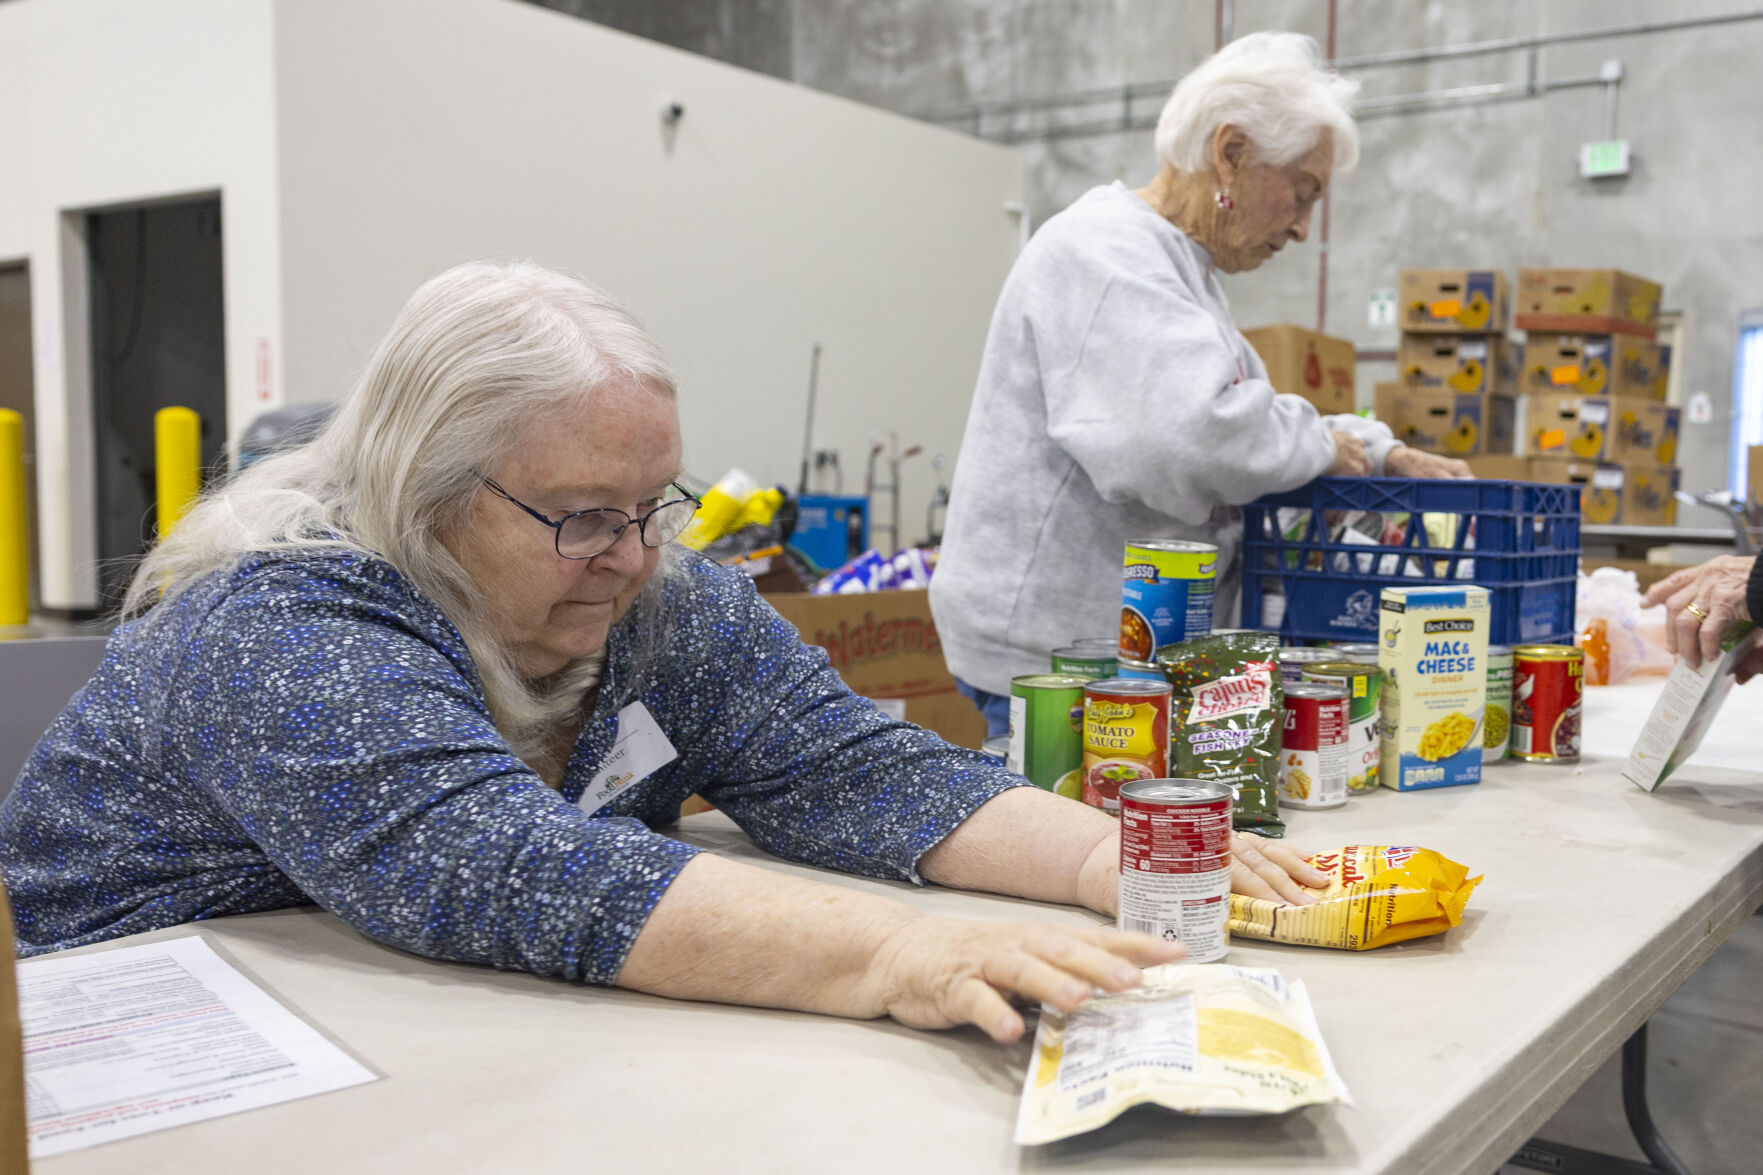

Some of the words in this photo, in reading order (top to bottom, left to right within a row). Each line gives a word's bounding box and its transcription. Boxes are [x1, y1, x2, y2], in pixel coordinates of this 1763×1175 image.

[1426, 622, 1443, 632] Best
[1444, 621, 1472, 631] Choice
[1424, 640, 1460, 657] MAC
[1462, 642, 1469, 654] &
[1416, 656, 1475, 675] CHEESE
[1431, 674, 1464, 684] DINNER
[1087, 722, 1136, 738] TOMATO
[1089, 735, 1128, 749] SAUCE
[1193, 741, 1225, 755] FISH
[613, 771, 636, 788] Bank
[1123, 809, 1149, 821] Nutrition
